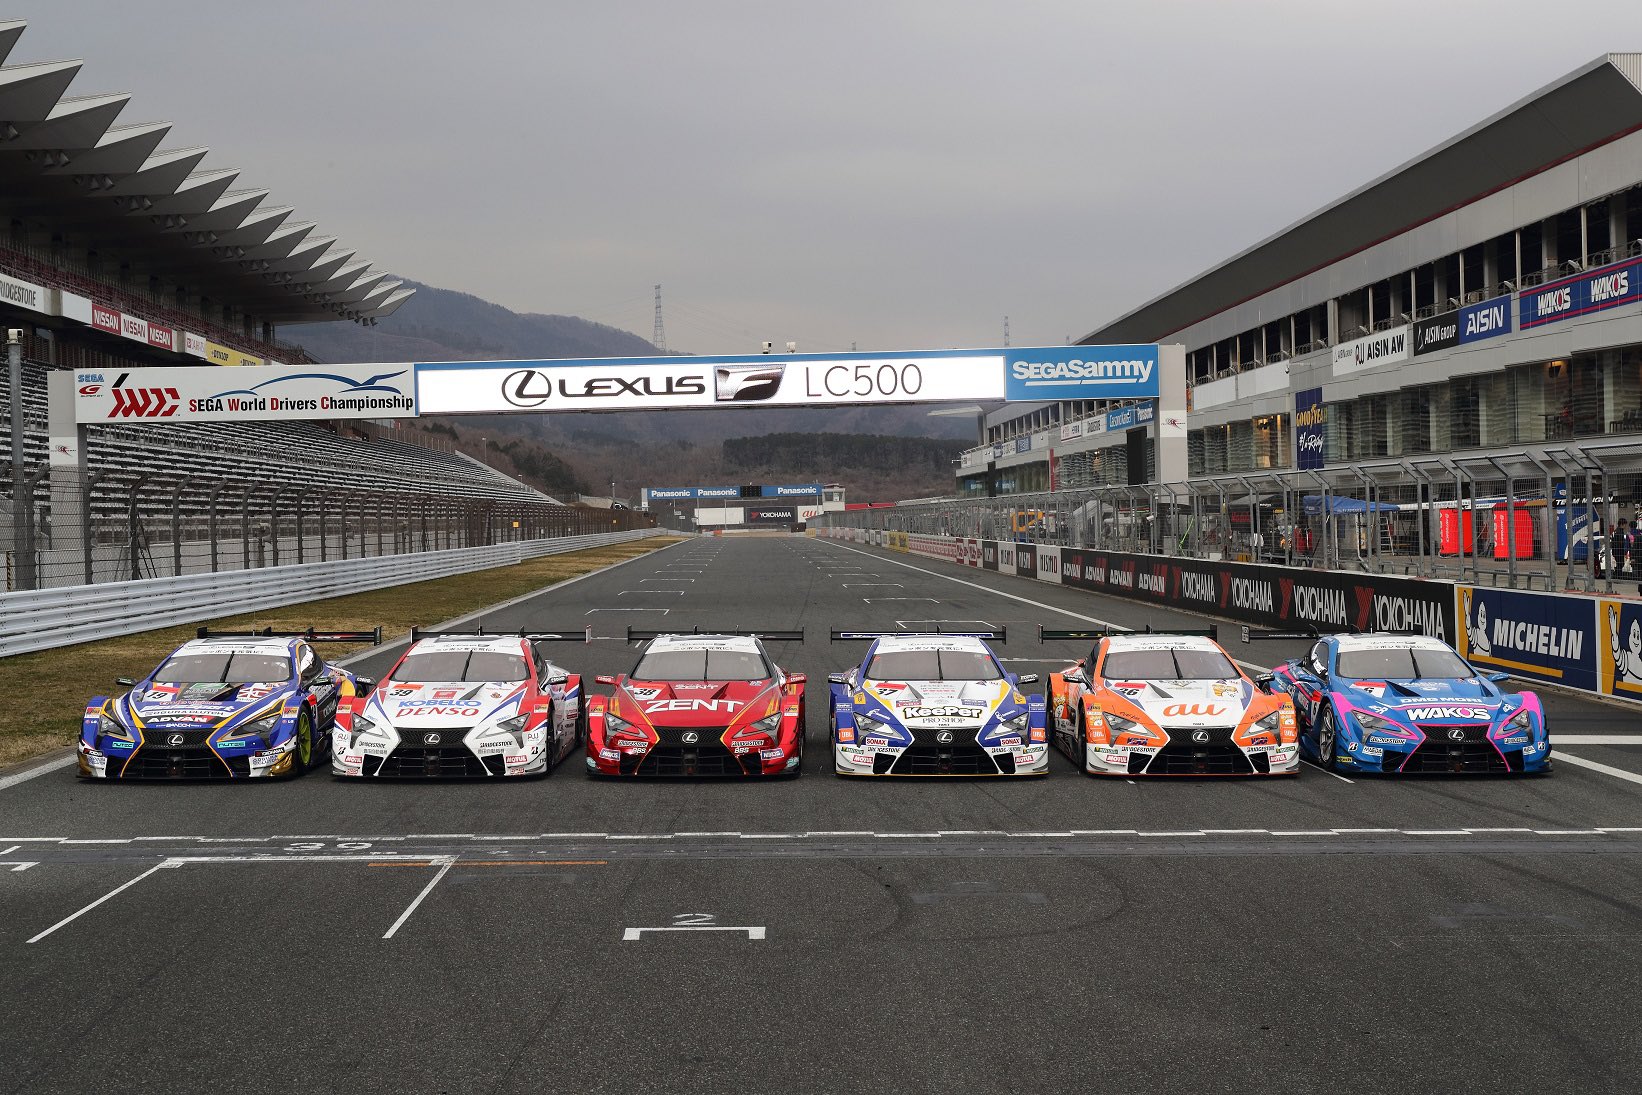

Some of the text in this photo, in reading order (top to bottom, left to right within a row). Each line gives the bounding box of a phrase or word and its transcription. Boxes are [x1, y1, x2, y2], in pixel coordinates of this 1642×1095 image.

[0, 280, 36, 307] RIDGESTONE
[94, 309, 119, 331] NISSAN
[124, 318, 146, 338] NISSAN
[1466, 304, 1504, 336] AISIN
[150, 327, 171, 346] NISSAN
[1424, 324, 1456, 345] AISIN GROUP
[1367, 338, 1389, 361] AISIN
[1391, 333, 1405, 355] AW
[78, 373, 105, 383] SEGA
[558, 363, 923, 398] LEXUS LC500
[189, 394, 414, 413] SEGA World Drivers Championship
[651, 489, 691, 497] Panasonic
[697, 488, 737, 496] Panasonic
[777, 487, 817, 495] Panasonic
[1556, 497, 1580, 506] TEM
[759, 511, 792, 519] YOKOHAMA
[801, 510, 817, 518] au
[1039, 553, 1058, 574] NISMO
[1063, 562, 1081, 579] ADVAN
[1085, 565, 1105, 583] ADVAN
[1109, 569, 1133, 588] ADVAN
[1138, 573, 1165, 593] ADVAN
[1181, 571, 1216, 603] YOKOHAMA
[1230, 576, 1274, 613] YOKOHAMA
[1293, 585, 1348, 626] YOKOHAMA
[1374, 594, 1446, 642] YOKOHAMA
[1493, 618, 1583, 660] MICHELIN
[389, 689, 414, 697] 39
[634, 688, 657, 696] 38
[877, 688, 899, 696] 37
[398, 699, 482, 708] KOBELCO
[644, 698, 744, 714] ZENT
[1162, 703, 1227, 717] au
[396, 706, 480, 718] DENSO
[904, 706, 983, 719] KeePer
[866, 738, 887, 746] SONAX
[1002, 738, 1020, 746] SONAX
[853, 755, 873, 763] MOTUL
[1107, 755, 1127, 763] MOTUL
[672, 913, 716, 925] 2
